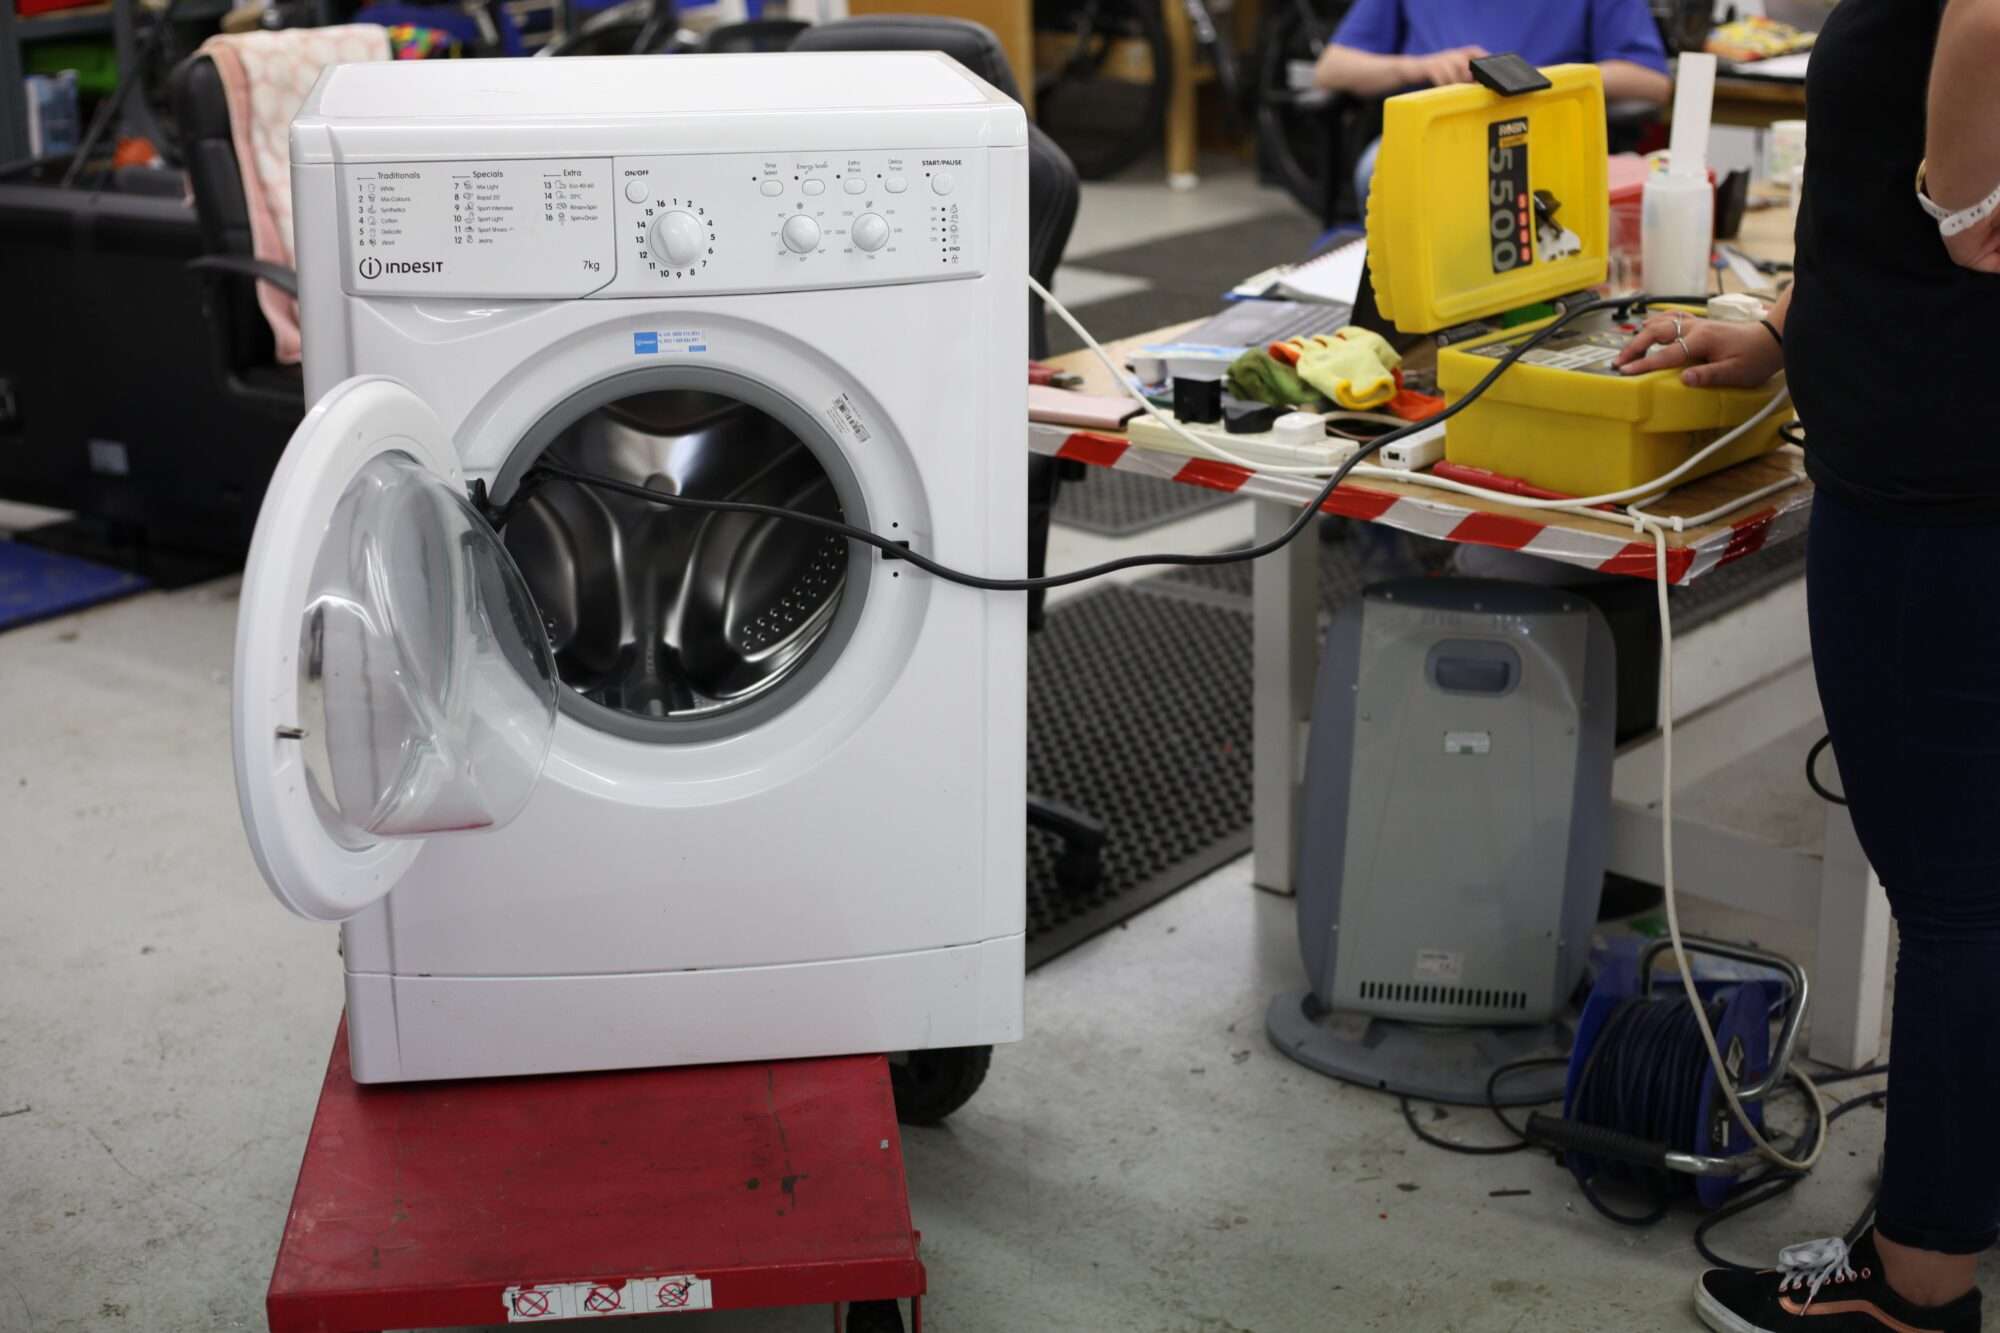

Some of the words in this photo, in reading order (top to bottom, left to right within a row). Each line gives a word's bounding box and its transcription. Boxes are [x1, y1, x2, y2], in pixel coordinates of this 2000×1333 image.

[378, 171, 421, 179] Traditionals
[472, 170, 504, 180] Specials
[563, 168, 582, 177] Extra
[656, 200, 666, 208] 16
[645, 208, 653, 216] 15
[1489, 148, 1518, 272] 5500
[640, 251, 648, 259] 12
[583, 258, 600, 272] 7kg
[660, 270, 669, 278] 10
